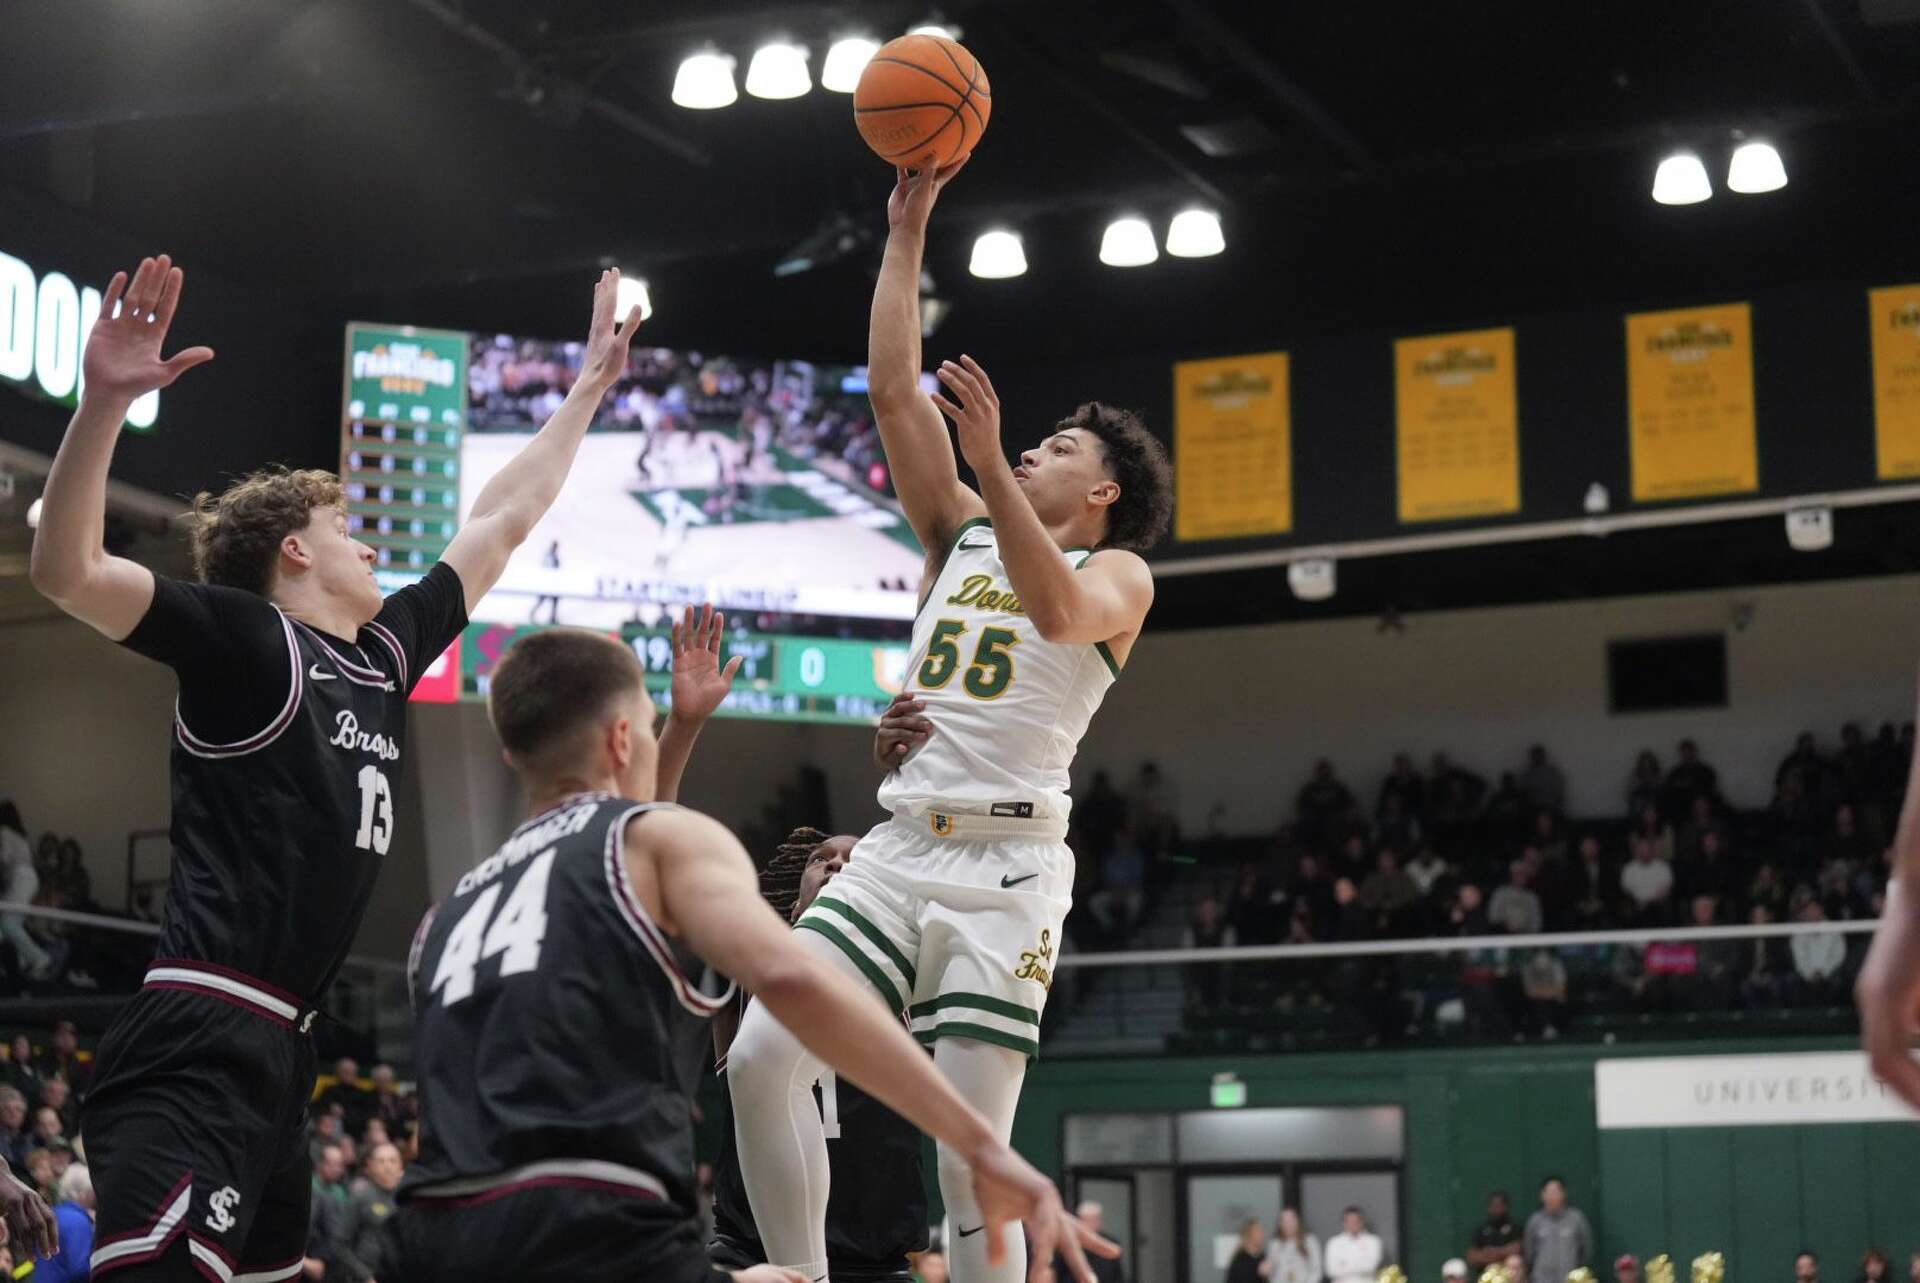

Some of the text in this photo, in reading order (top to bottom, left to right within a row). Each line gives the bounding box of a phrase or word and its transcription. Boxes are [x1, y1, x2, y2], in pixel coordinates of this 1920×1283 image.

[800, 647, 826, 688] 0
[918, 619, 1023, 701] 55
[354, 764, 394, 856] 13
[429, 846, 558, 1007] 44
[1693, 1076, 1888, 1105] UNIVERSIT
